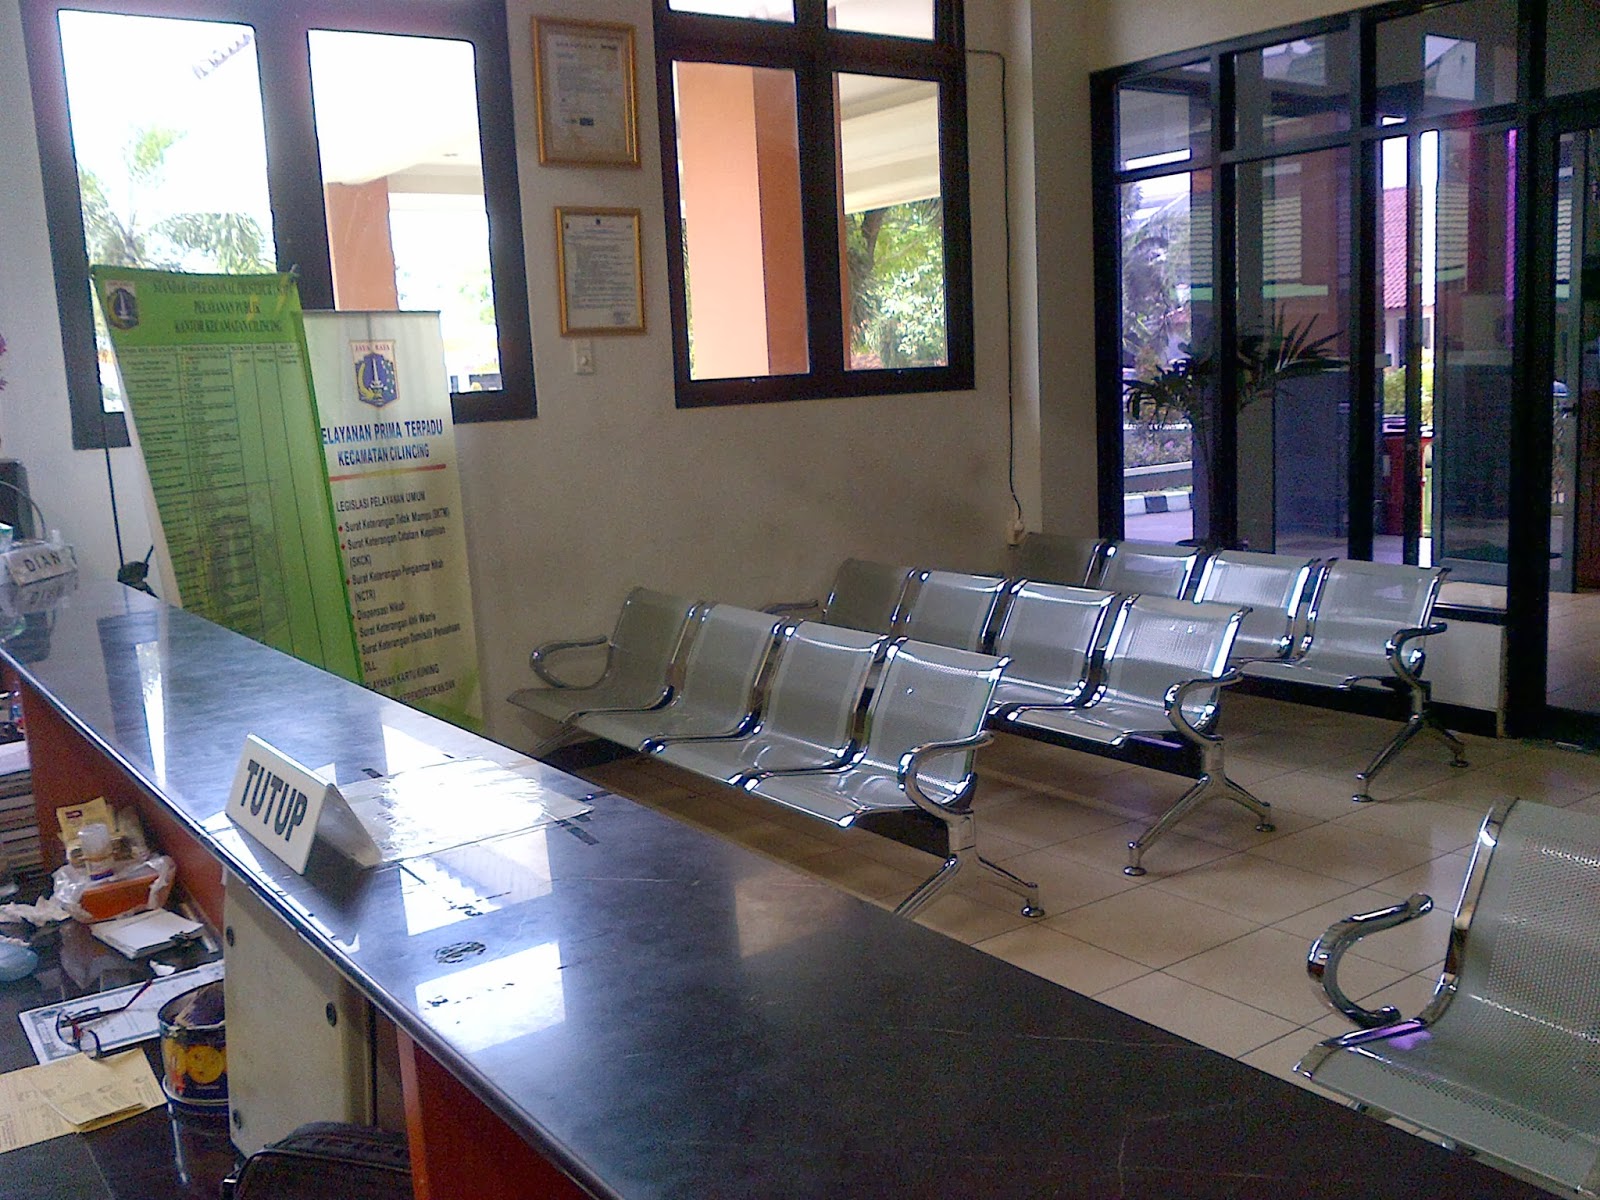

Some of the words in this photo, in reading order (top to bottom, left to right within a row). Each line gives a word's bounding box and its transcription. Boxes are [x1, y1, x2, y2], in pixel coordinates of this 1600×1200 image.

[321, 425, 371, 445] ELAYANAN
[374, 421, 402, 441] PRIMA
[404, 418, 444, 438] TERPADU
[337, 446, 389, 466] KECAMATAN
[389, 443, 430, 462] CILINCING
[336, 500, 369, 512] LEGISLASI
[370, 494, 404, 508] PELAYANAN
[344, 521, 362, 533] Surat
[362, 516, 395, 529] Keterangan
[347, 539, 364, 551] Surat
[364, 533, 397, 547] Keterangan
[23, 551, 62, 573] DIAN
[351, 574, 369, 586] Surat
[240, 759, 308, 842] TUTUP
